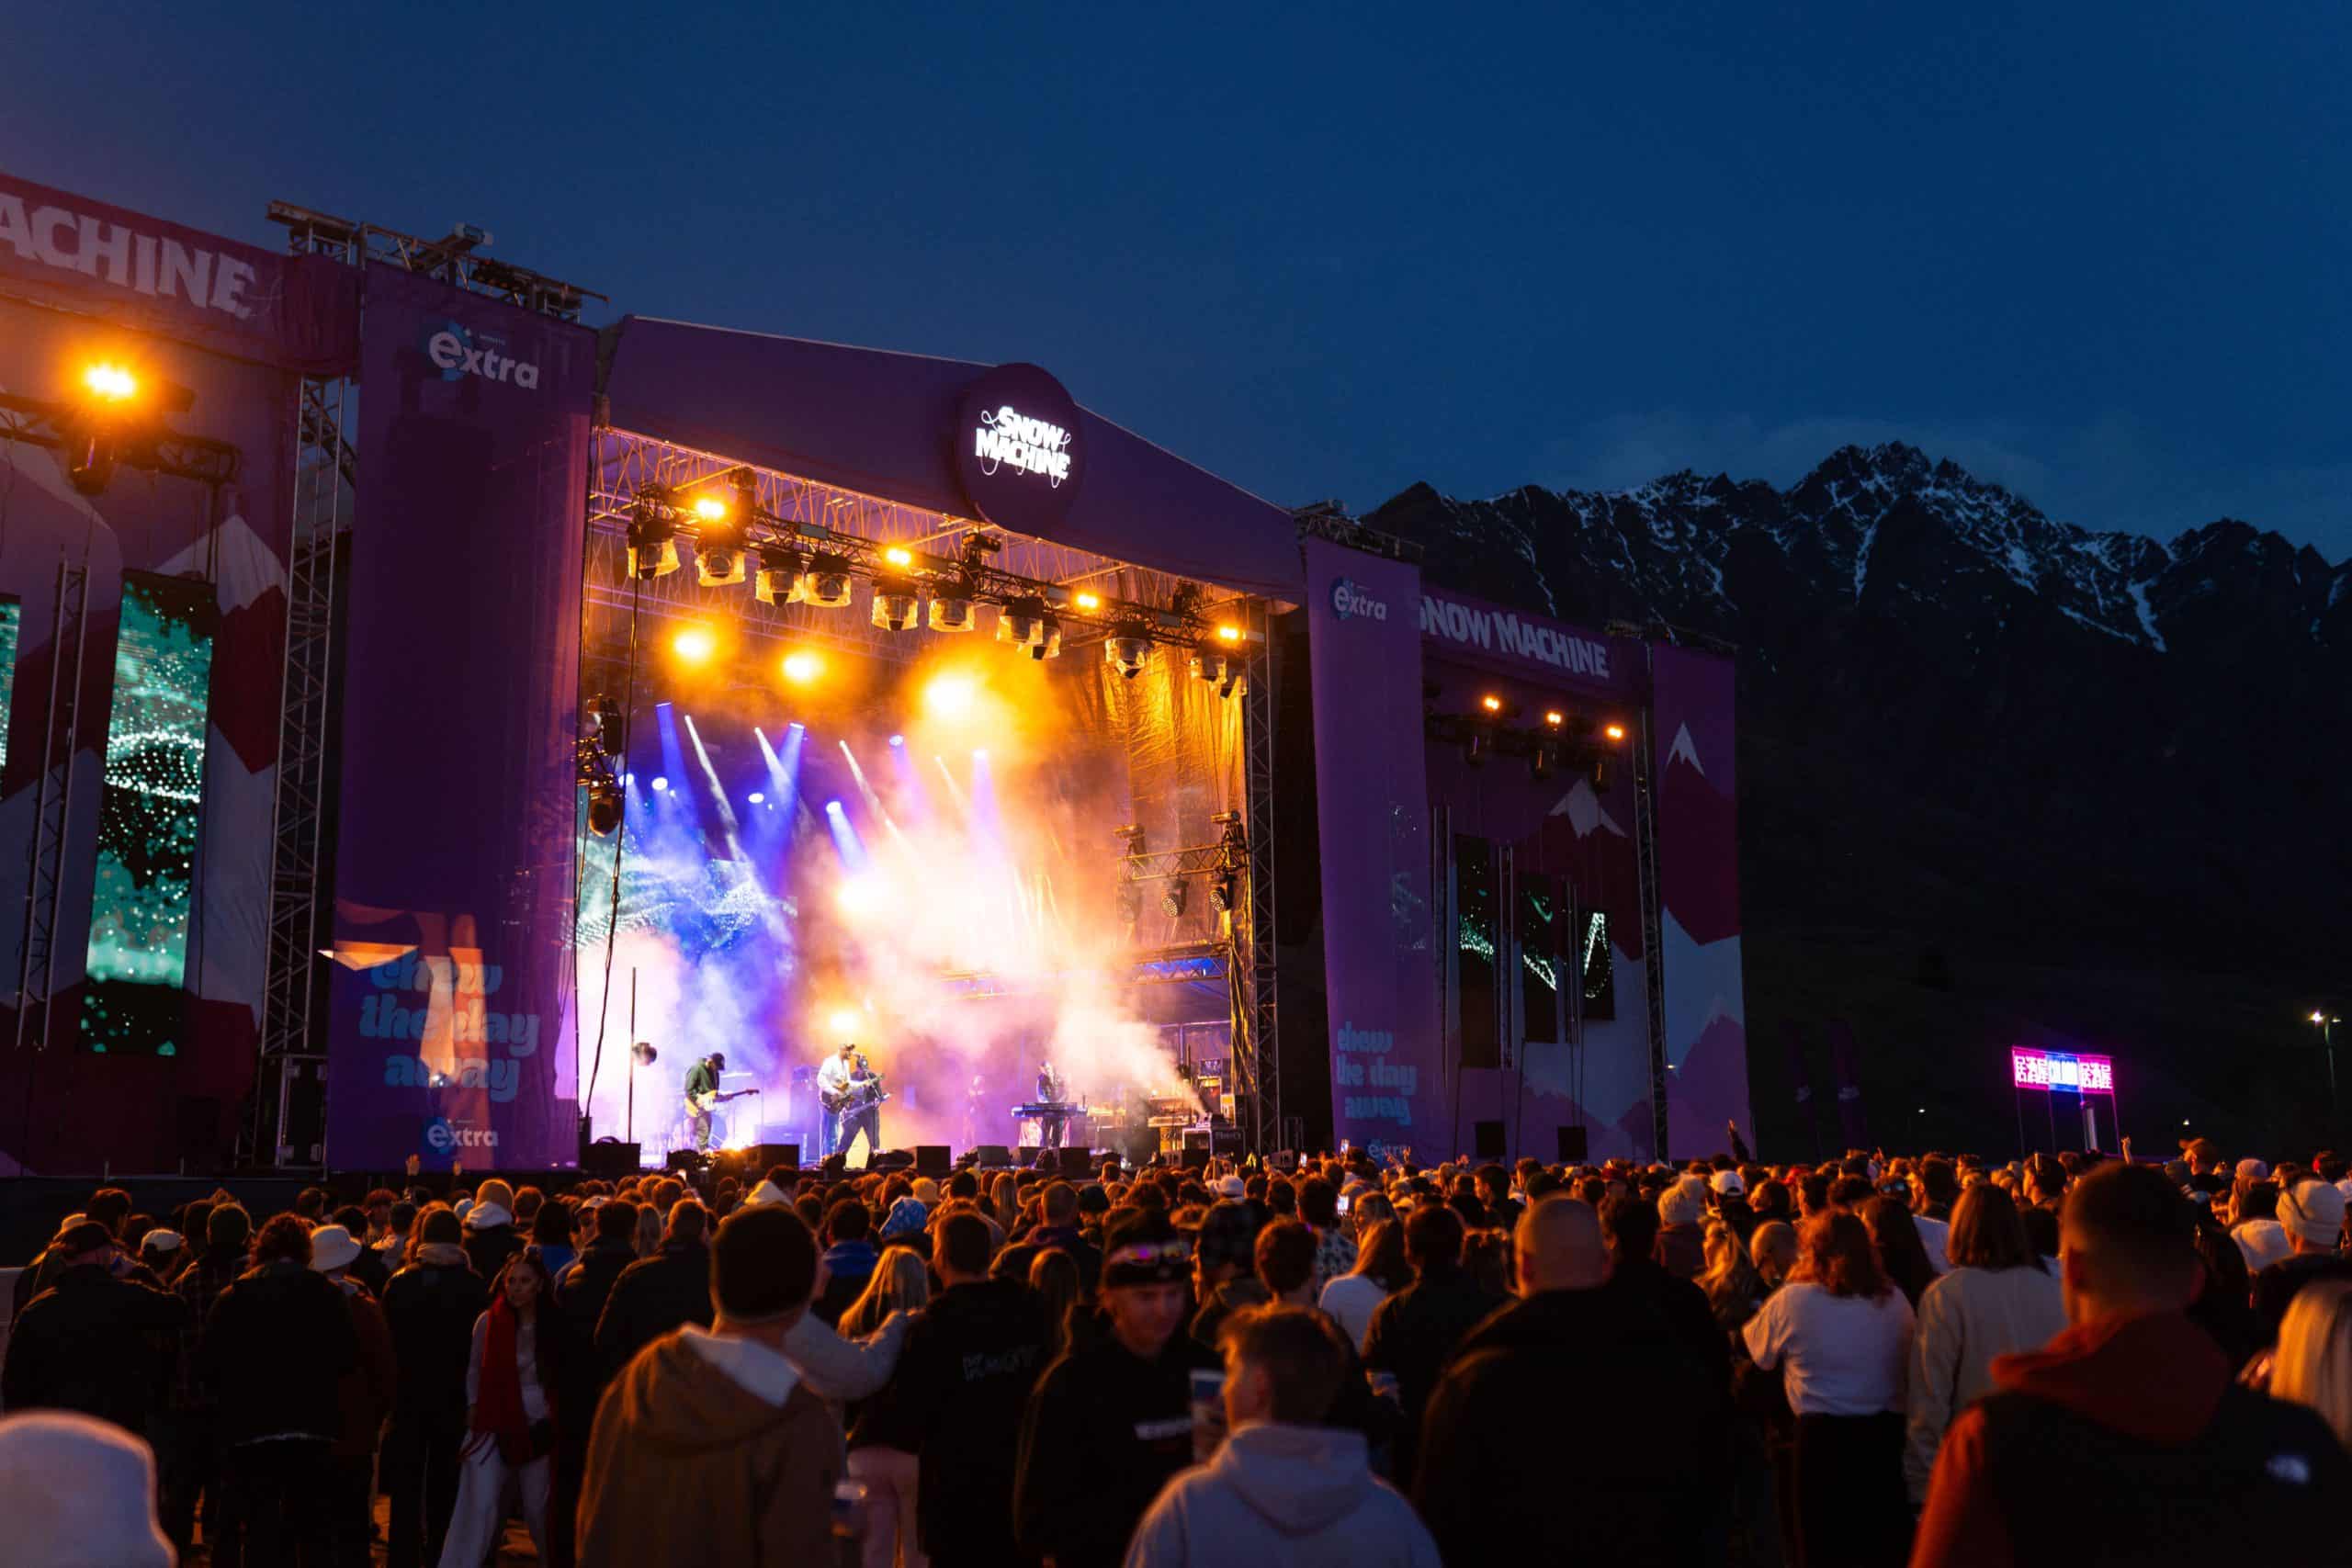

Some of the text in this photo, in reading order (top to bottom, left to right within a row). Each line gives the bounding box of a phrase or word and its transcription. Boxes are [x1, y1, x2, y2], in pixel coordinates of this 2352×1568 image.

[429, 331, 539, 390] extra
[996, 406, 1067, 451] SNOW
[976, 428, 1071, 481] MACHINE
[1334, 586, 1388, 621] extra
[1491, 610, 1611, 679] MACHINE
[451, 998, 540, 1057] day
[1369, 1055, 1419, 1096] day
[426, 1123, 500, 1148] extra
